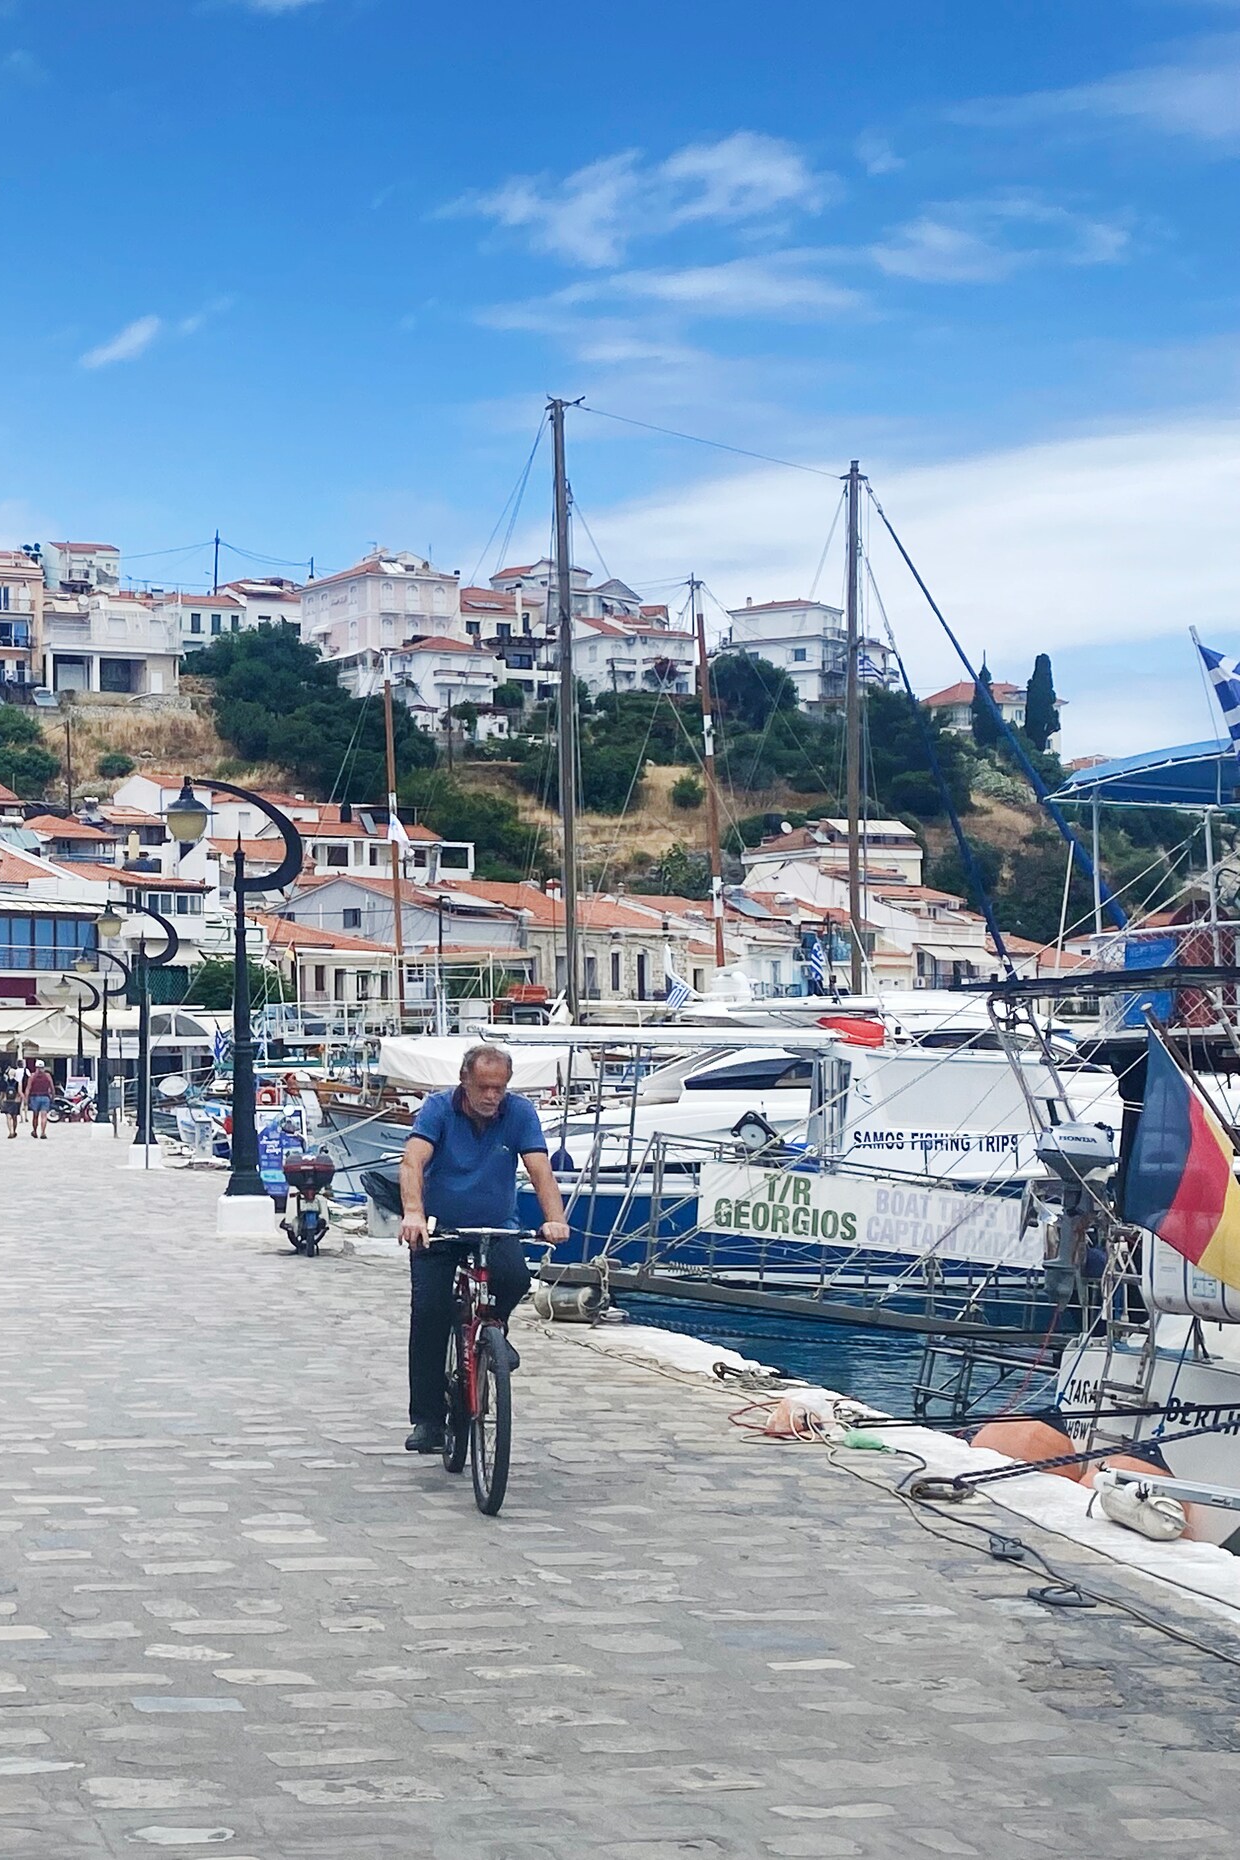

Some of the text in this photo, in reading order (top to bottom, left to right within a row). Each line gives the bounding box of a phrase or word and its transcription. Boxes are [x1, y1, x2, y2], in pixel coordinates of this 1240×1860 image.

[853, 1131, 1018, 1153] SAMOS FISHING TRIPS
[1059, 1135, 1097, 1144] HONDA
[764, 1173, 811, 1206] T/R
[714, 1198, 857, 1241] GEORGIOS
[876, 1188, 932, 1220] BOAT
[939, 1196, 998, 1228] TRIPS
[866, 1216, 958, 1251] CAPTAIN
